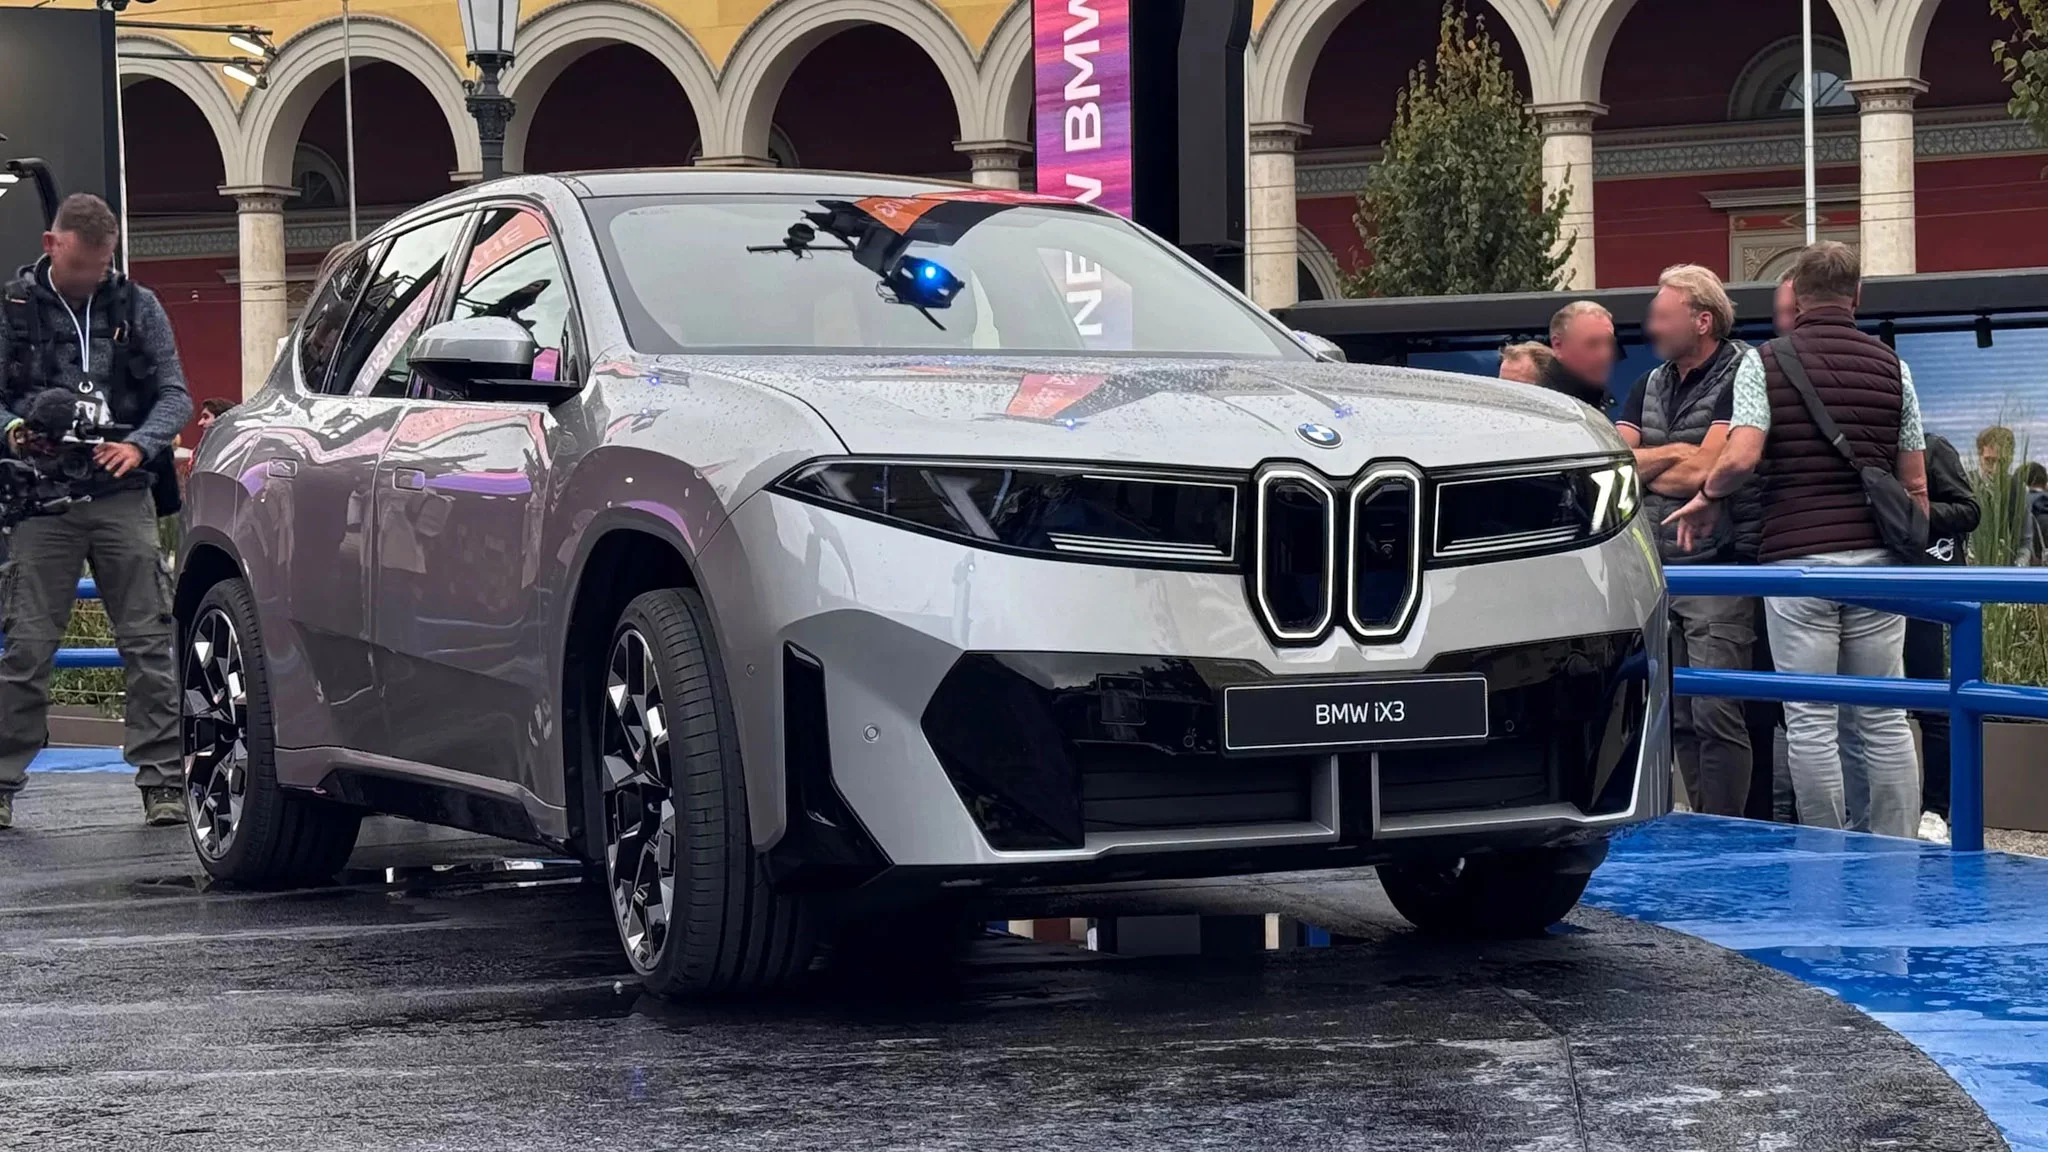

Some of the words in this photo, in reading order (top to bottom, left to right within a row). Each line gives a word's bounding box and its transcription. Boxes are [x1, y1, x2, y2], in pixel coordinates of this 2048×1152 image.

[1064, 0, 1101, 152] BMW
[1315, 702, 1369, 725] BMW
[1374, 700, 1405, 723] iX3
